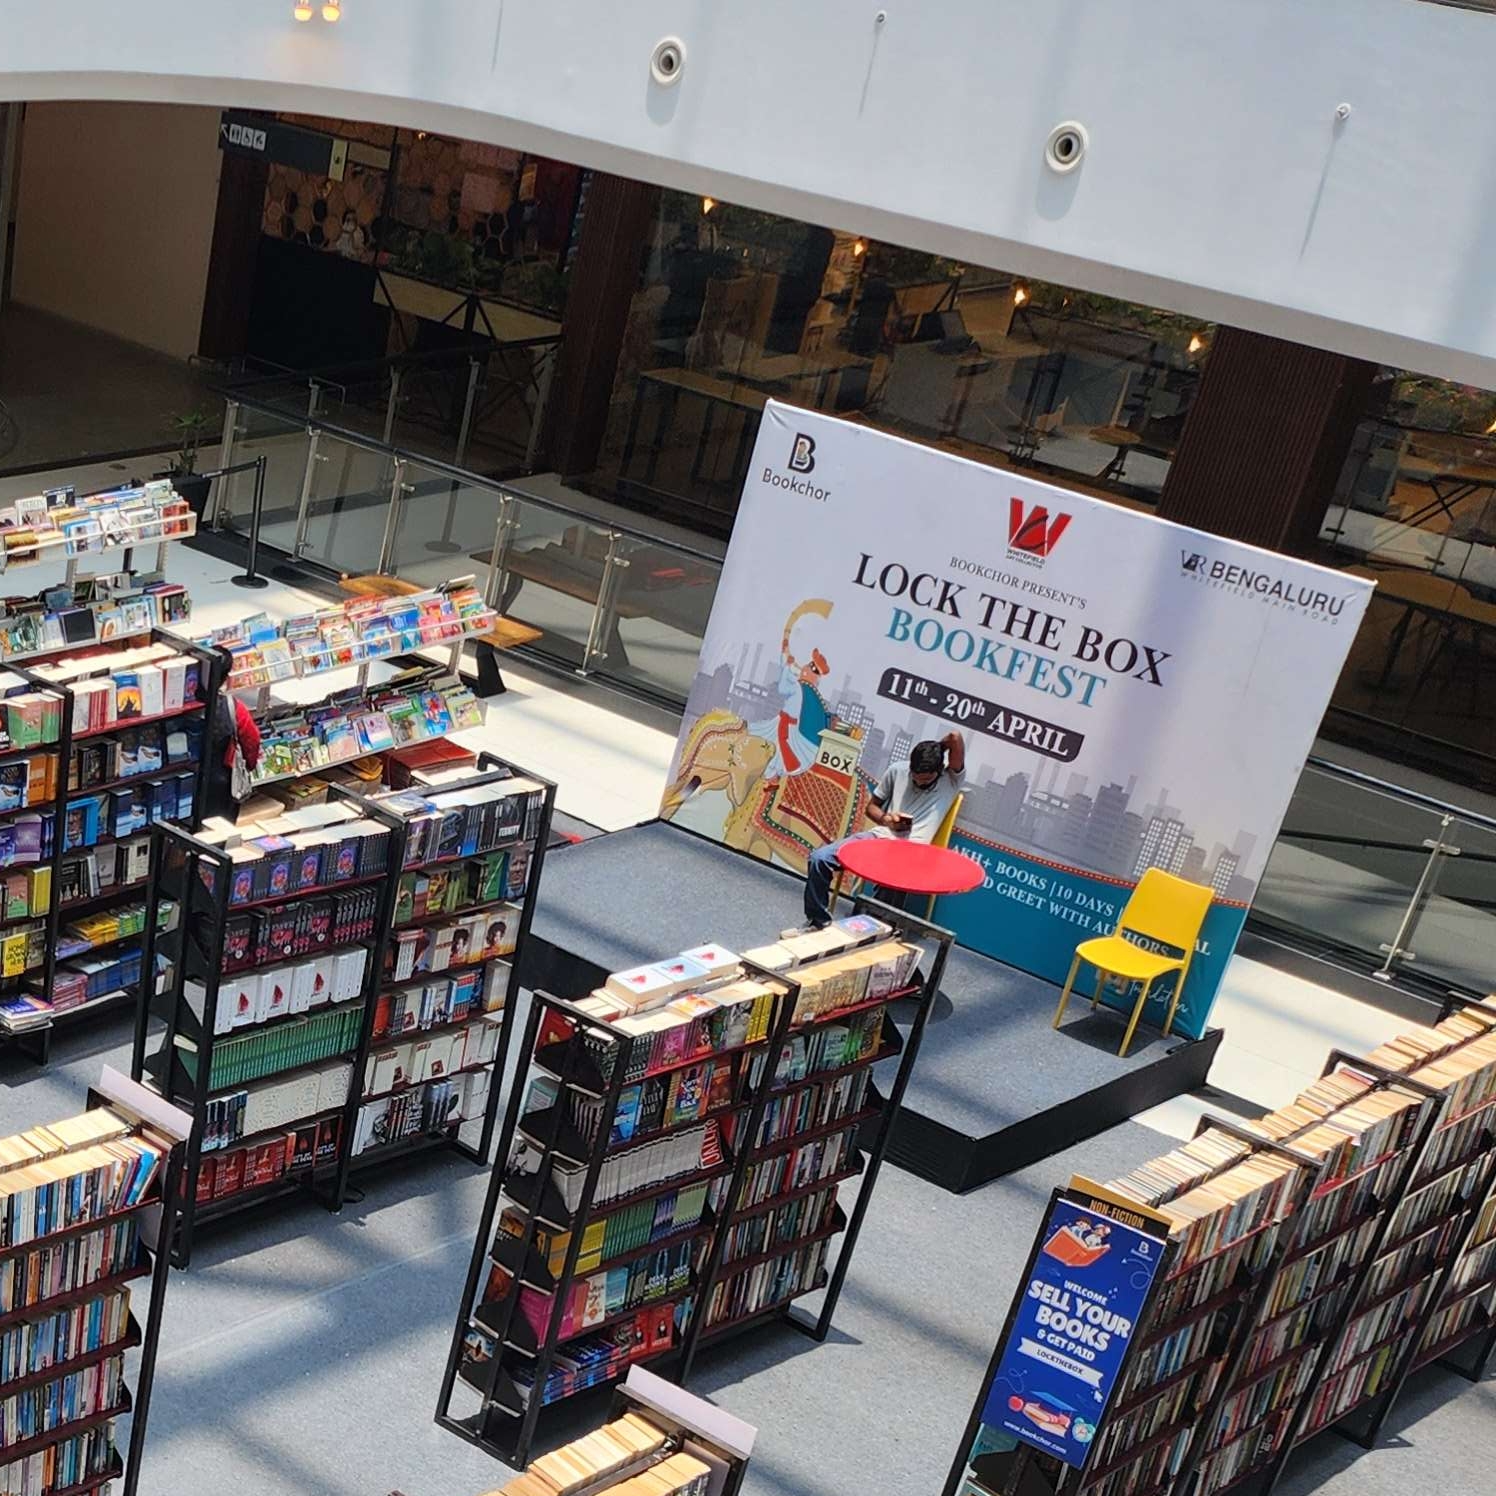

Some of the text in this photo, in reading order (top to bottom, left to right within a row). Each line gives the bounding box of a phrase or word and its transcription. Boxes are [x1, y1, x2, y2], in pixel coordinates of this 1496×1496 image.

[761, 467, 832, 502] Bookchor
[950, 556, 1088, 610] BOOKCHOR PRESENT'S
[1210, 560, 1347, 617] BENGALURU
[852, 552, 1172, 687] LOCK THE BOX
[1262, 596, 1296, 612] MAIN
[1303, 609, 1340, 626] ROAD
[885, 607, 1108, 709] BOOKFEST
[887, 673, 929, 700] 11th
[942, 693, 987, 721] 20th
[987, 711, 1069, 758] APRIL
[819, 750, 852, 773] BOX
[994, 861, 1048, 891] BOOKS
[1075, 892, 1115, 917] DAYS
[996, 882, 1046, 910] GREET
[1049, 901, 1090, 928] WITH
[1089, 1200, 1145, 1229] NON-FICTION
[1028, 1279, 1132, 1338] SELL YOUR
[1064, 1279, 1108, 1305] WELCOME
[1035, 1304, 1111, 1352] BOOKS
[1036, 1328, 1096, 1362] & GET PAID
[1035, 1347, 1084, 1376] LOCKTHEBOX
[1004, 1420, 1067, 1455] www.bookchor.com
